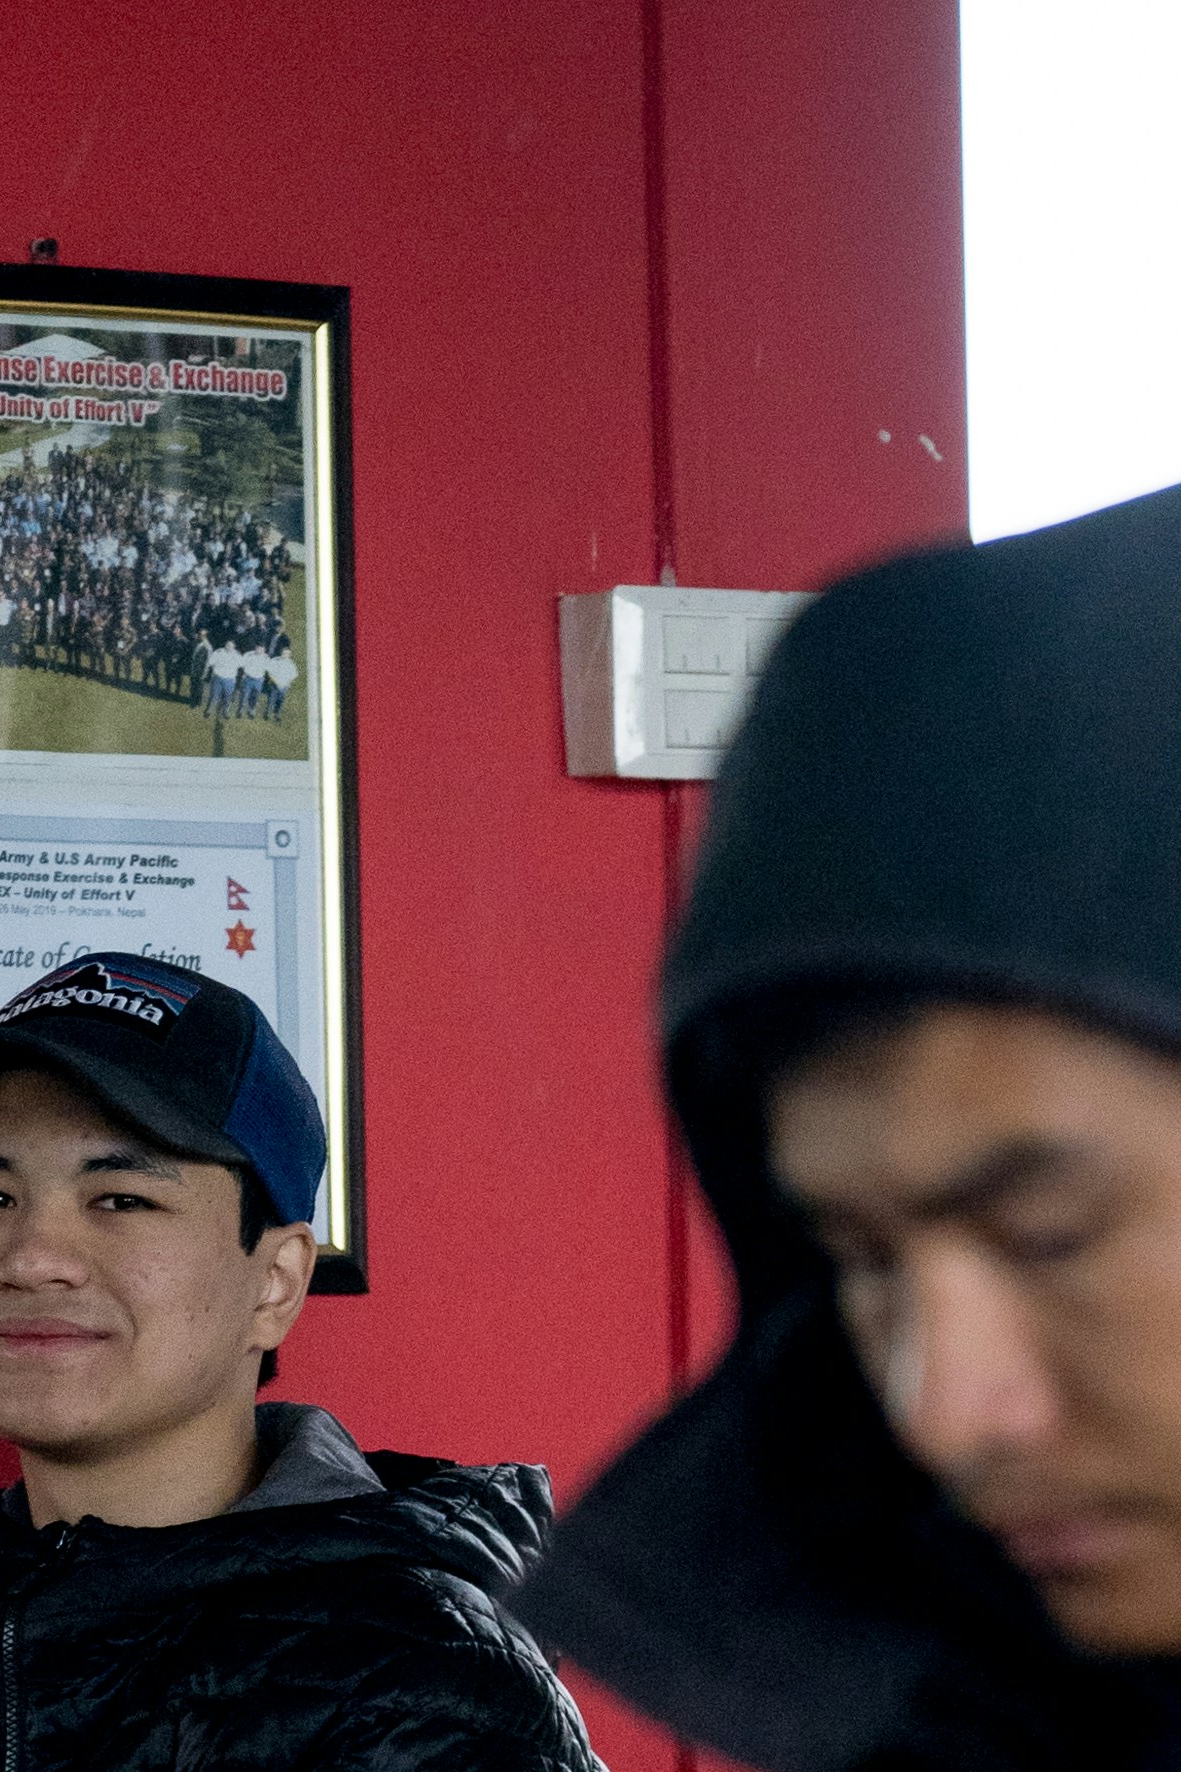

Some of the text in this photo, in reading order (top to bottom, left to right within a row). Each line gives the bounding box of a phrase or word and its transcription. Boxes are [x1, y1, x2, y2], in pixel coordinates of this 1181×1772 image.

[43, 355, 143, 387] Exercise
[149, 365, 162, 386] &
[172, 362, 284, 397] Exchange
[49, 400, 69, 418] of
[75, 399, 123, 421] Effort
[39, 852, 49, 865] &
[84, 854, 125, 869] Army
[129, 854, 179, 869] Pacific
[53, 871, 114, 884] Exercise
[118, 872, 128, 884] &
[133, 873, 195, 889] Exchange
[24, 887, 58, 902] Unity
[61, 888, 75, 900] of
[81, 889, 122, 901] Effort
[125, 889, 136, 901] V
[41, 941, 70, 969] of
